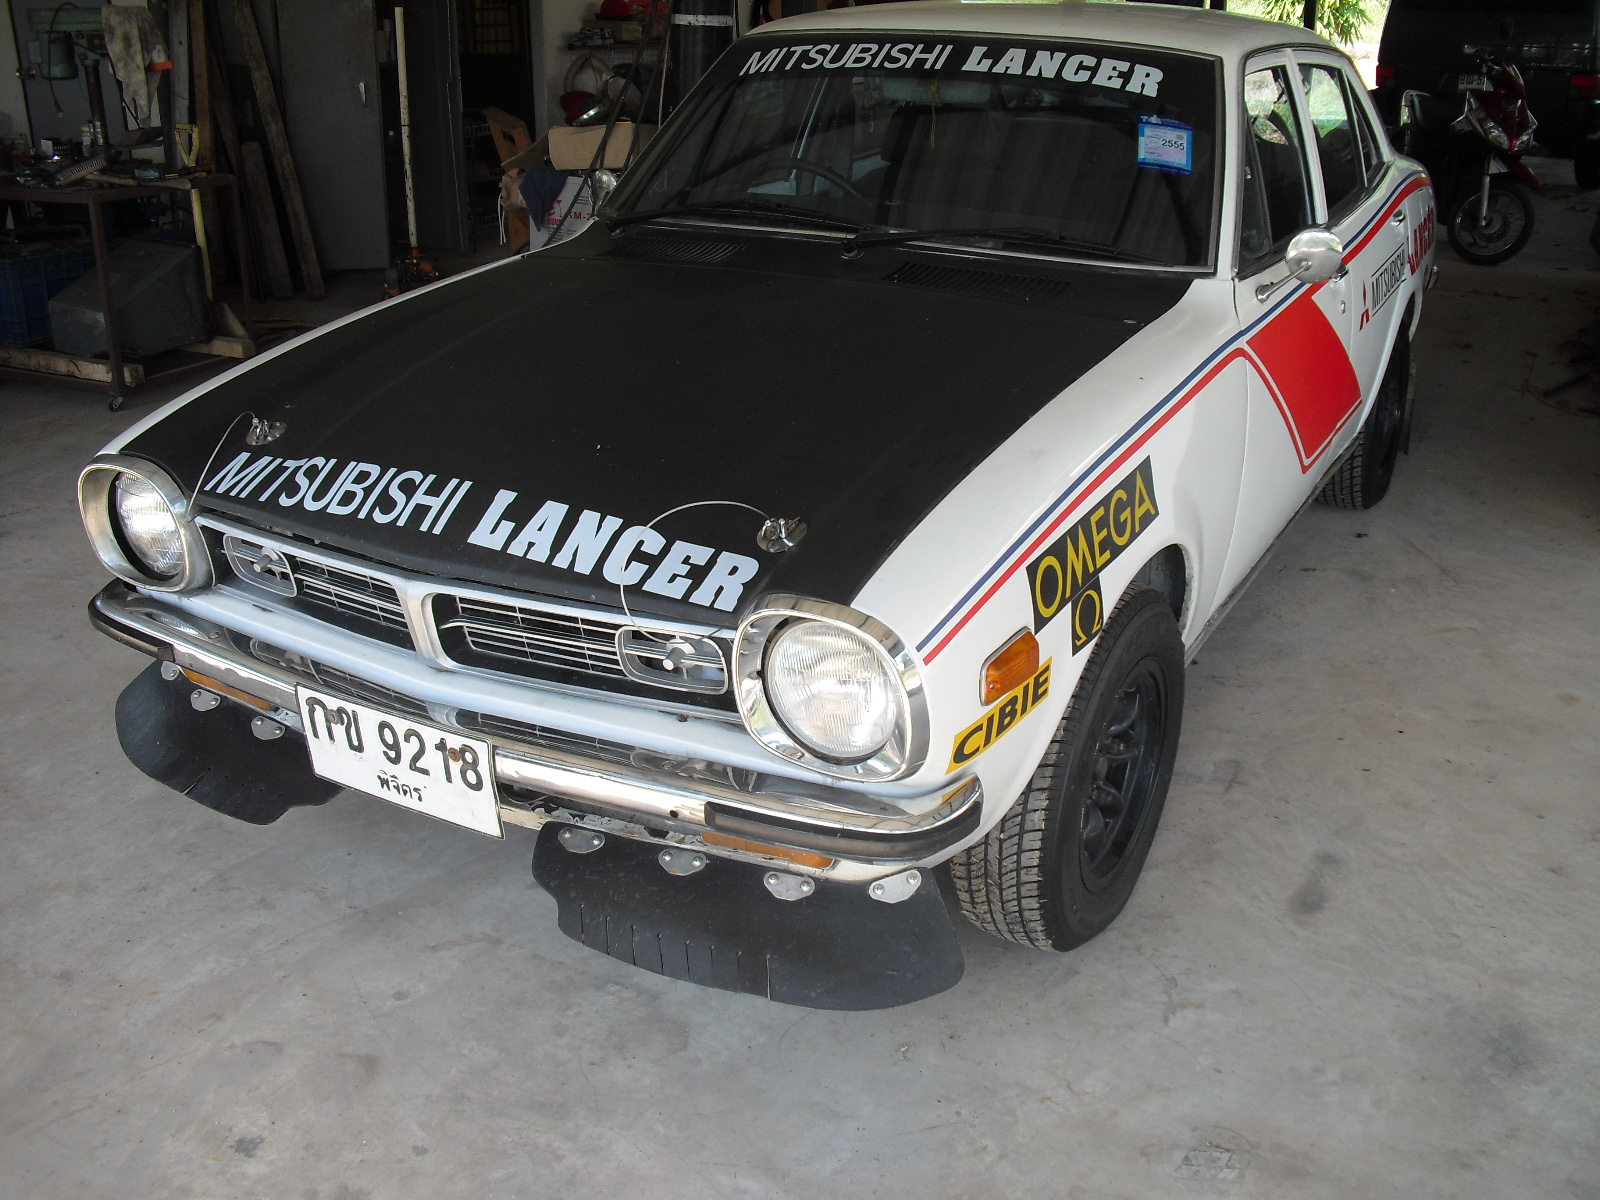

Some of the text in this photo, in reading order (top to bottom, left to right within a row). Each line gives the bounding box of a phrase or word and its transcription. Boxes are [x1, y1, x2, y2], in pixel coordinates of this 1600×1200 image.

[739, 43, 1164, 97] MITSUBISHI LANCER
[1161, 139, 1185, 150] 2555
[204, 452, 760, 612] MITSUBISHI LANCER
[1035, 470, 1156, 618] OMEGA
[377, 720, 484, 792] 9218
[952, 666, 1050, 765] CIBIE
